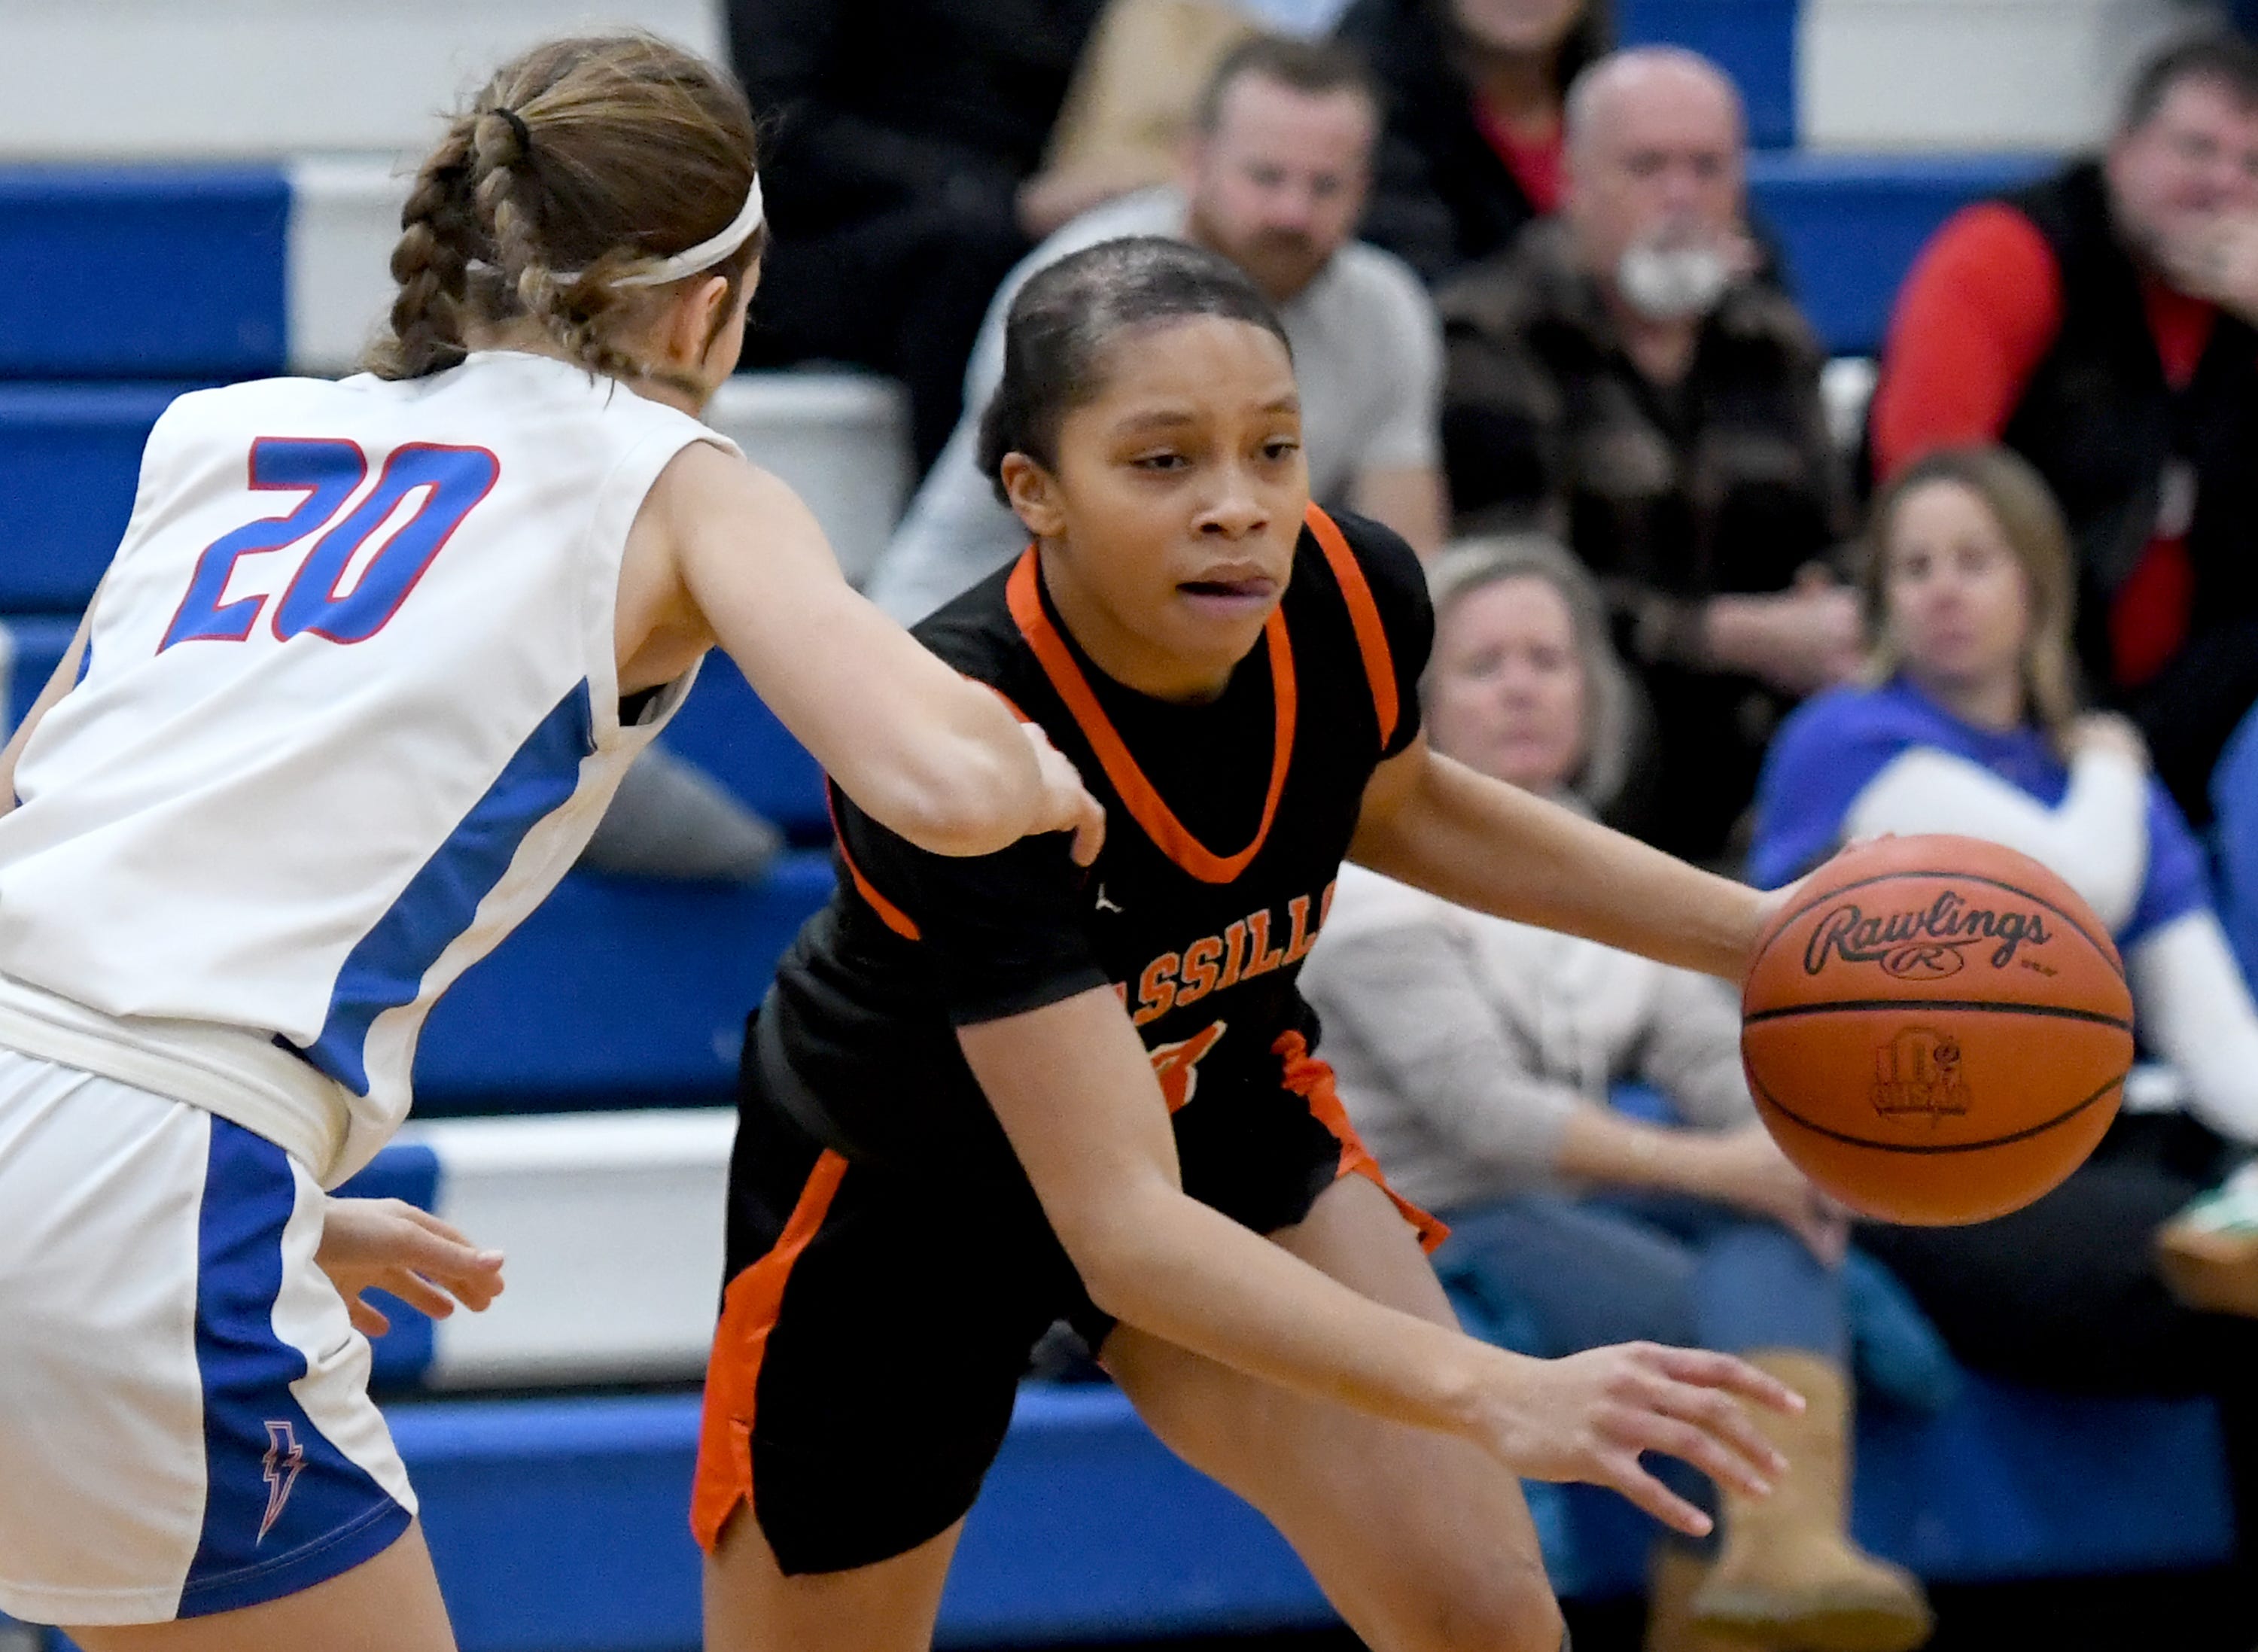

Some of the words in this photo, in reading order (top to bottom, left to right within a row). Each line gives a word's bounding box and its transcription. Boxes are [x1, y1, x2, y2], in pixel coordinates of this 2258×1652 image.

[154, 436, 501, 657] 20
[1112, 878, 1337, 1027] SSILL
[1803, 890, 2053, 975] Rawlings
